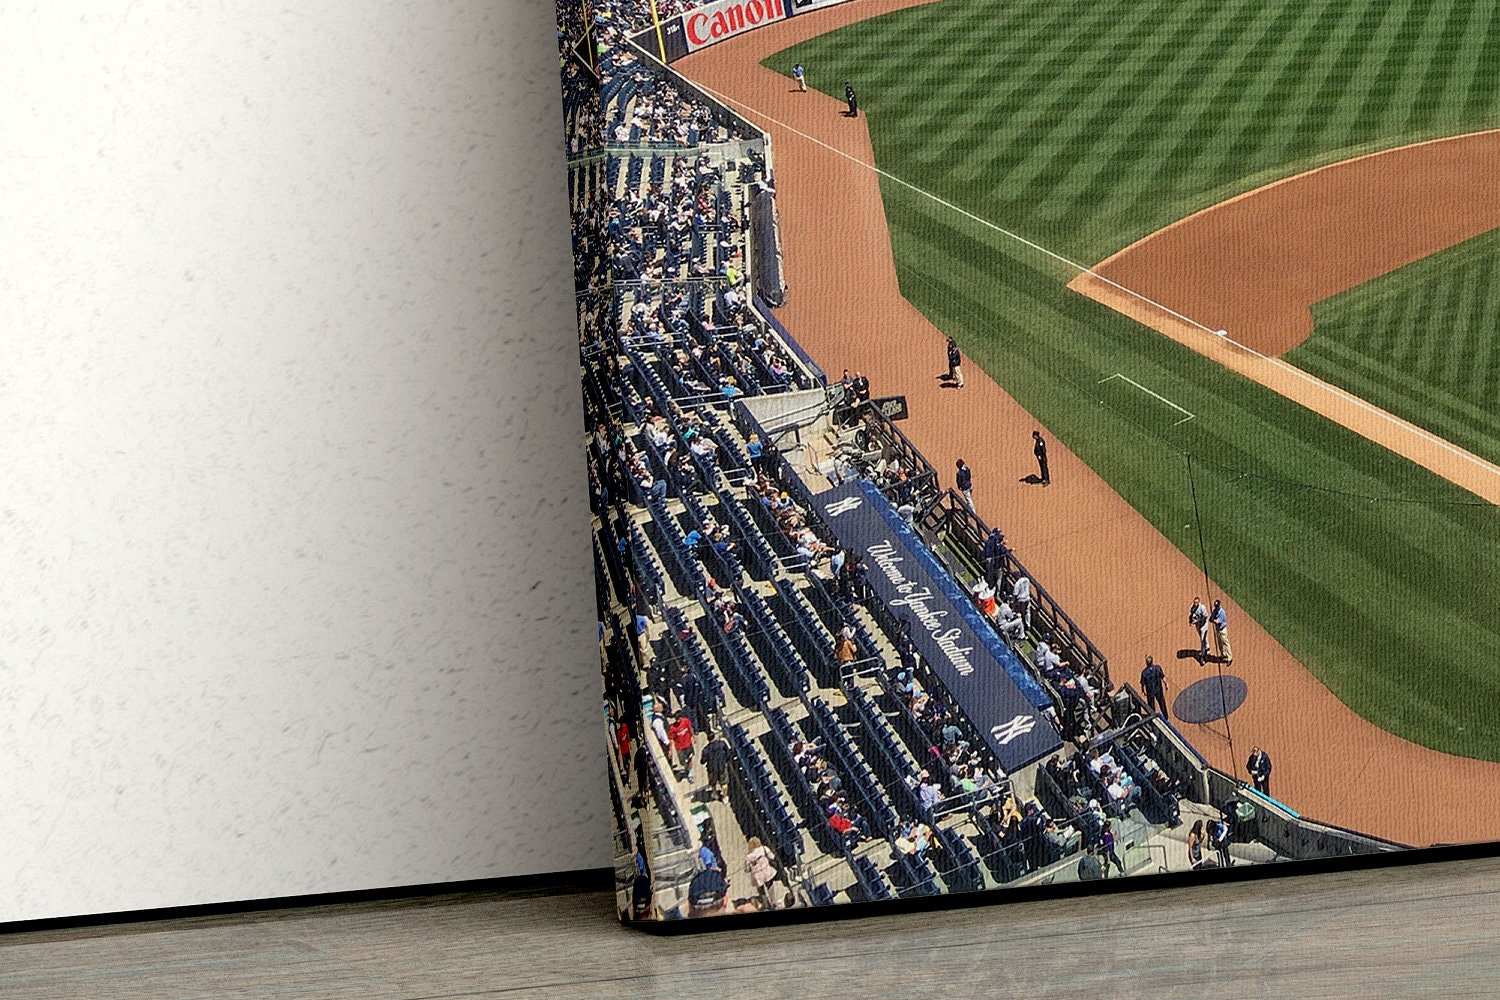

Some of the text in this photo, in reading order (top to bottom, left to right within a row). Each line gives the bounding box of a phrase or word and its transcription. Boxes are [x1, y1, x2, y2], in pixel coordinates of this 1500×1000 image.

[866, 539, 975, 677] Welcome to Yankee Stadium
